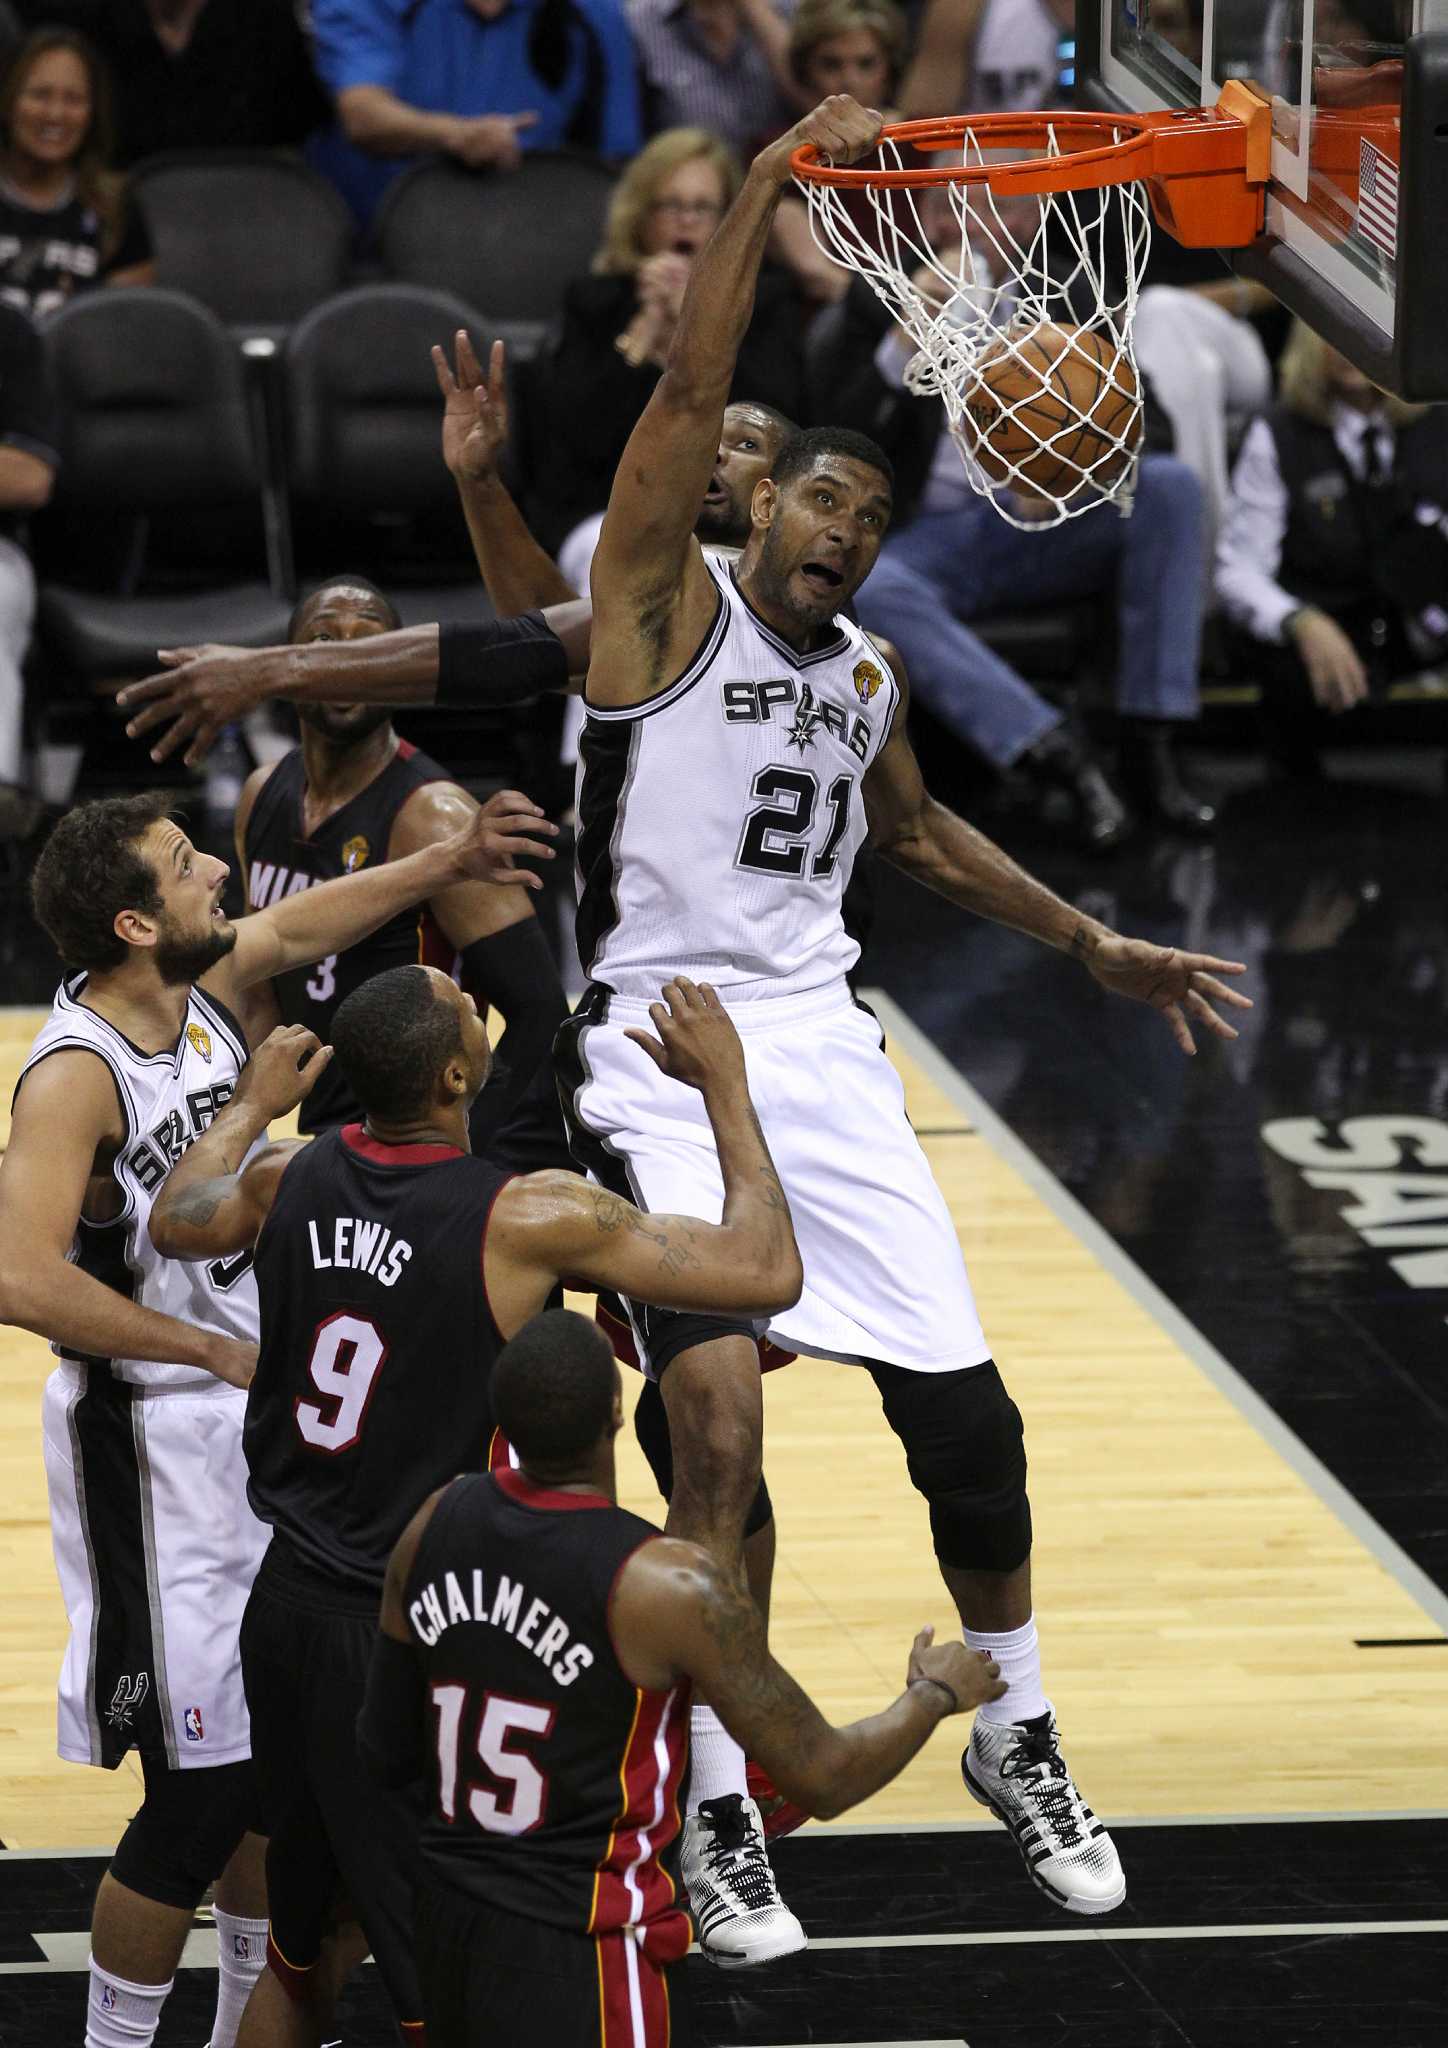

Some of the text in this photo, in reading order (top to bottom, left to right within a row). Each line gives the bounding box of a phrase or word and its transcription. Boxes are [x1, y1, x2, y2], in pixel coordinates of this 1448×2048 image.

[721, 676, 872, 764] SPURS
[733, 763, 853, 881] 21
[250, 861, 327, 909] MIA
[305, 954, 338, 1002] 3
[308, 1217, 413, 1287] LEWIS
[295, 1308, 388, 1456] 9
[409, 1568, 594, 1686] CHALMERS
[430, 1678, 558, 1836] 15
